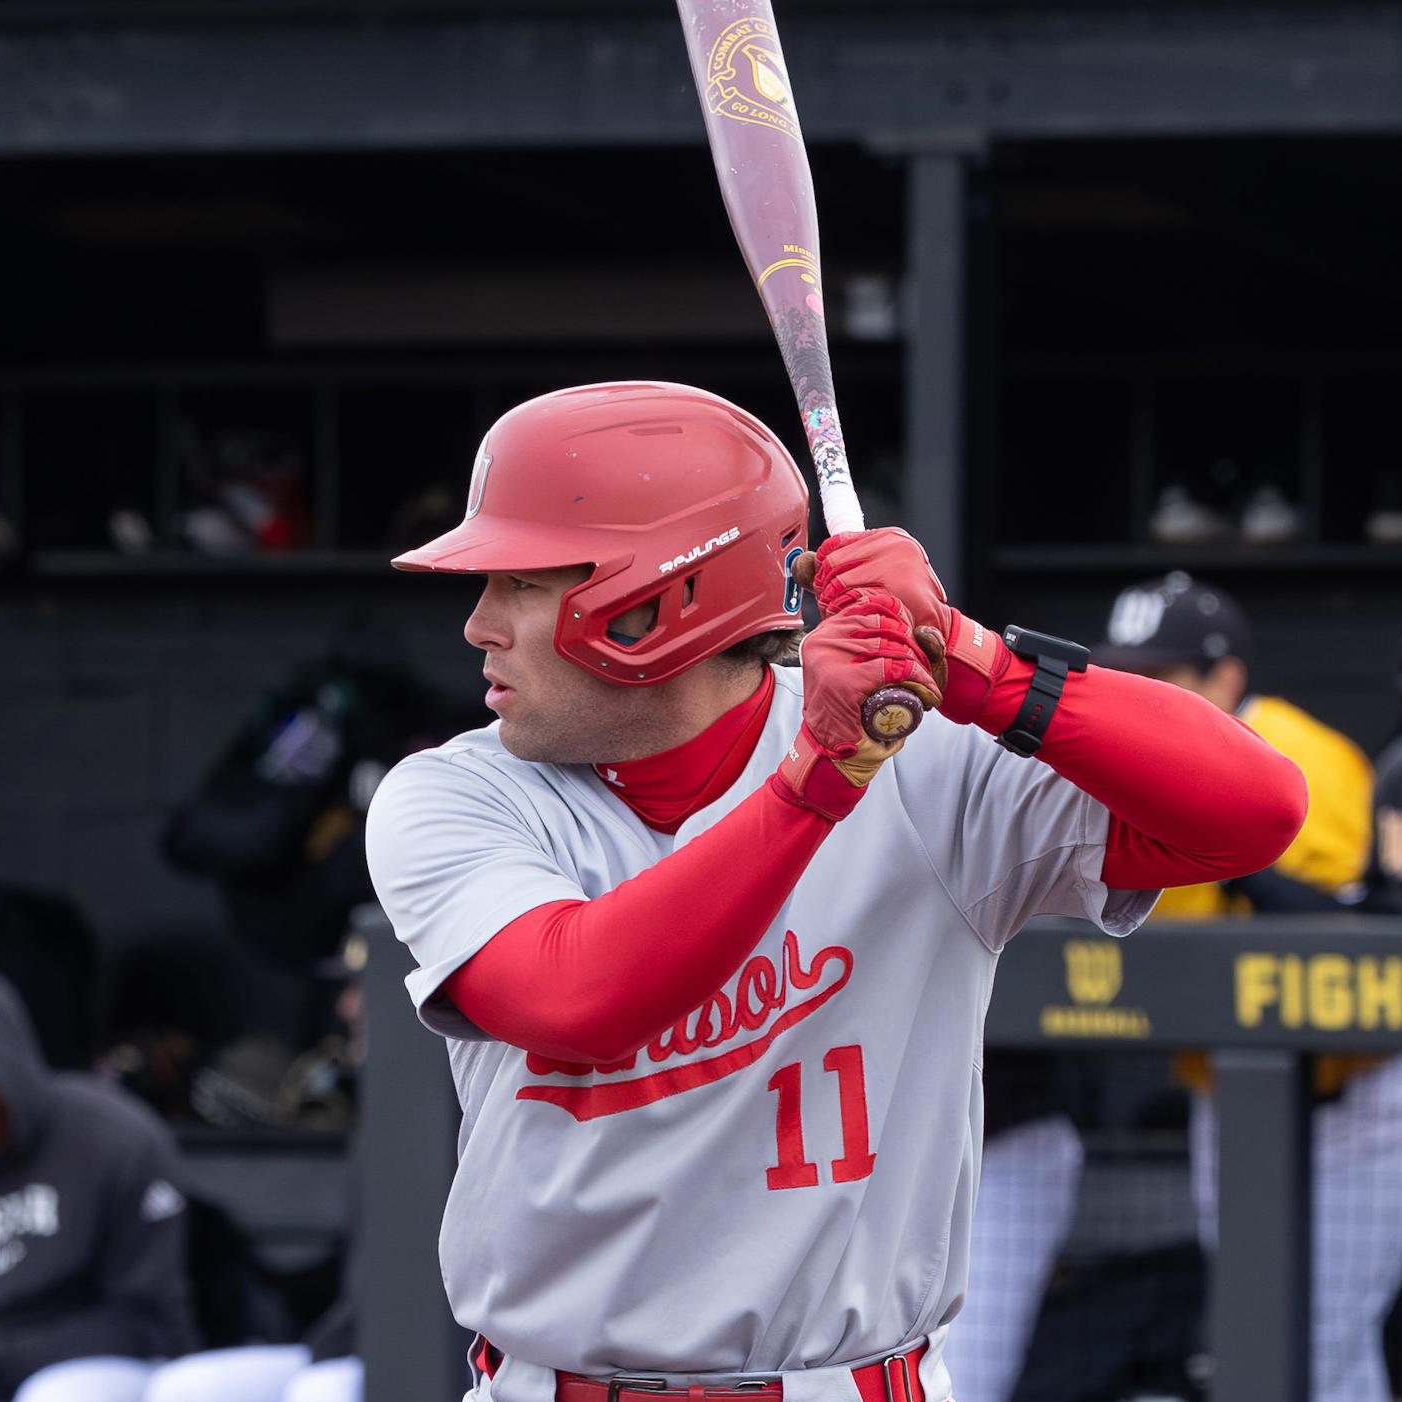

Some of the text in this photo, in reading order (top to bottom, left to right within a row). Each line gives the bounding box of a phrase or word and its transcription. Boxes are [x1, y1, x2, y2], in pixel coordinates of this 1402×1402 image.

[731, 101, 749, 113] GO
[749, 108, 787, 129] LONG
[659, 526, 741, 574] RAWLINGS
[766, 1044, 877, 1190] 11
